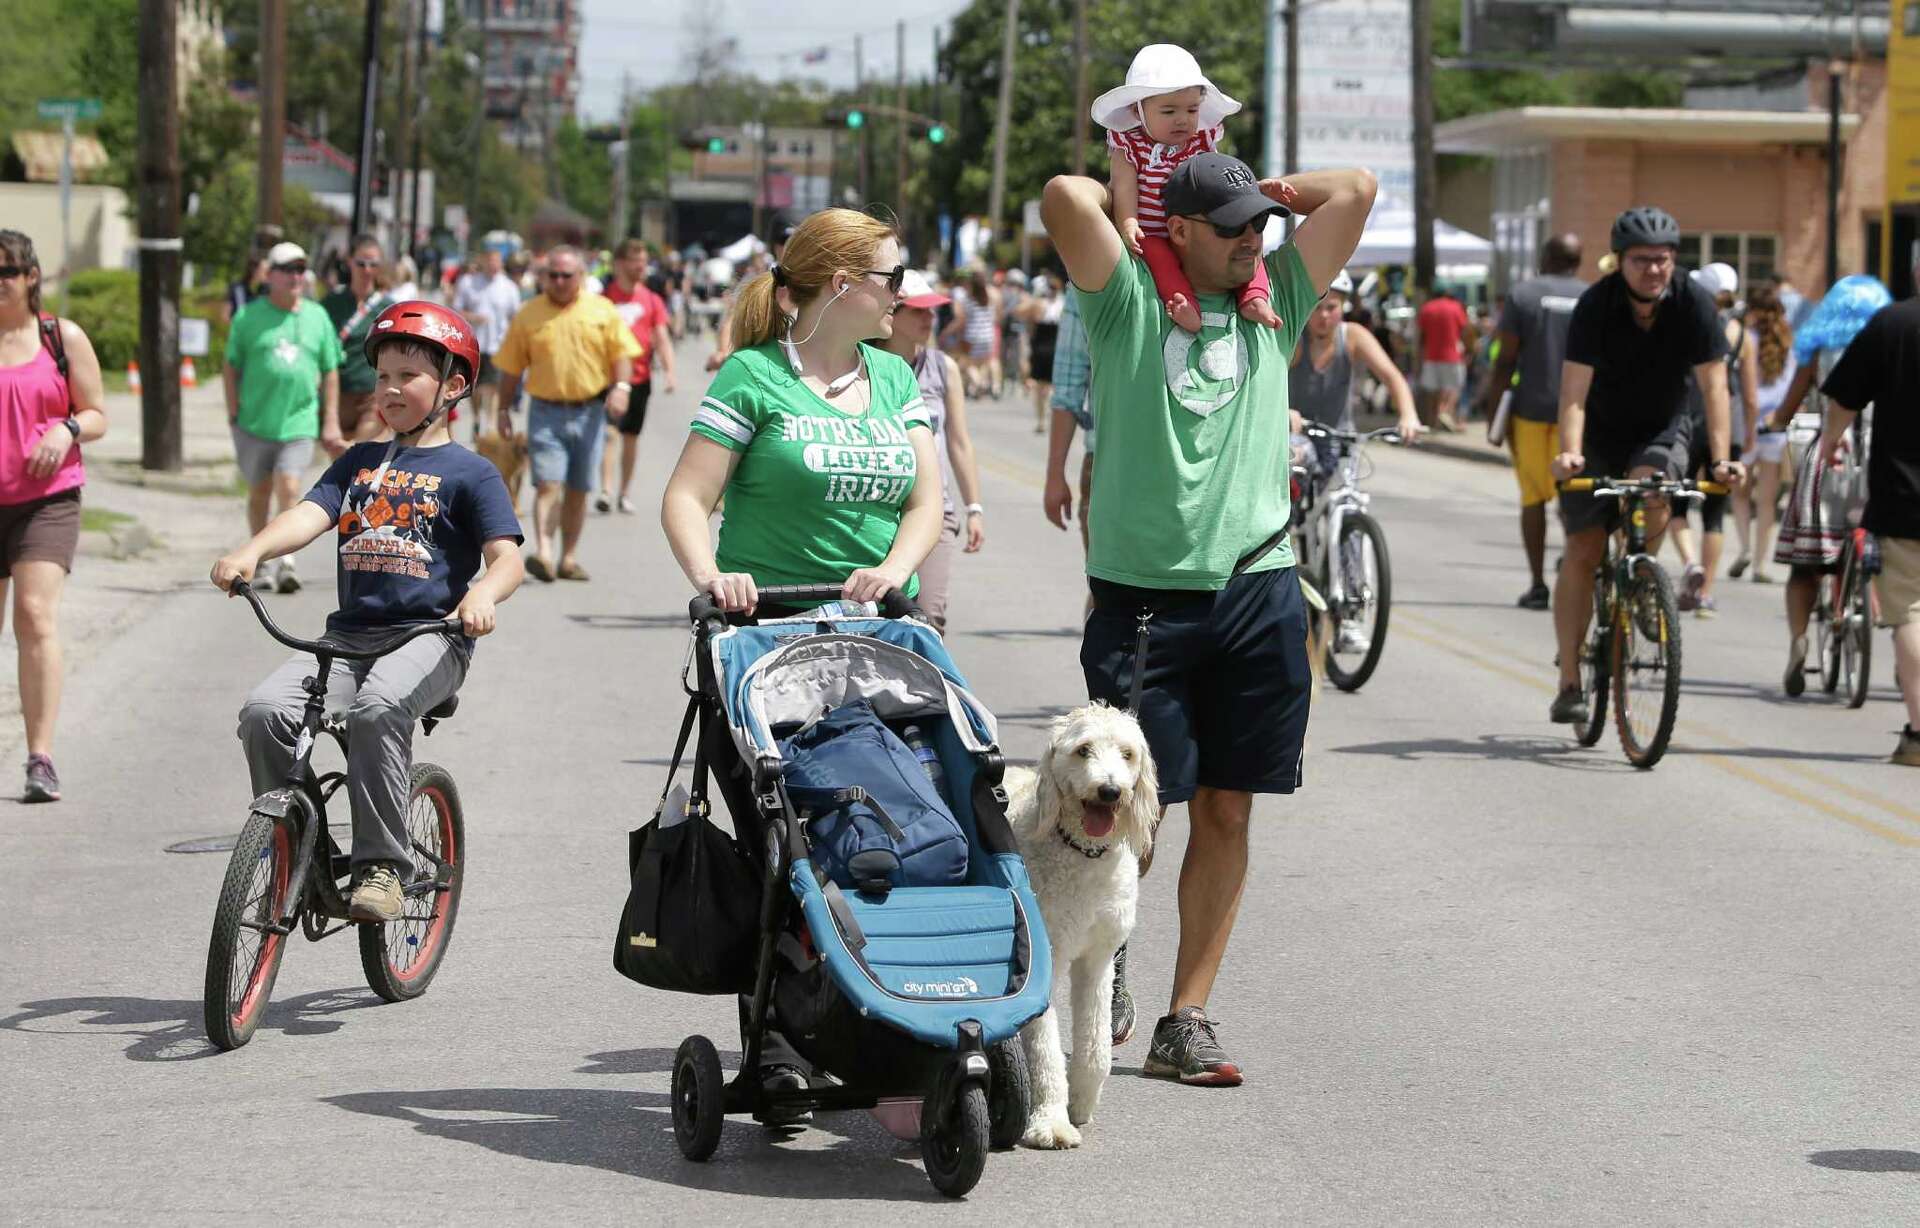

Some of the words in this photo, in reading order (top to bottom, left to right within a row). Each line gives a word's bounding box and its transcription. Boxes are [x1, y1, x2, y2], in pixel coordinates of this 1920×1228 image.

[820, 448, 889, 471] LOVE
[412, 473, 442, 492] 55
[825, 475, 909, 504] IRISH
